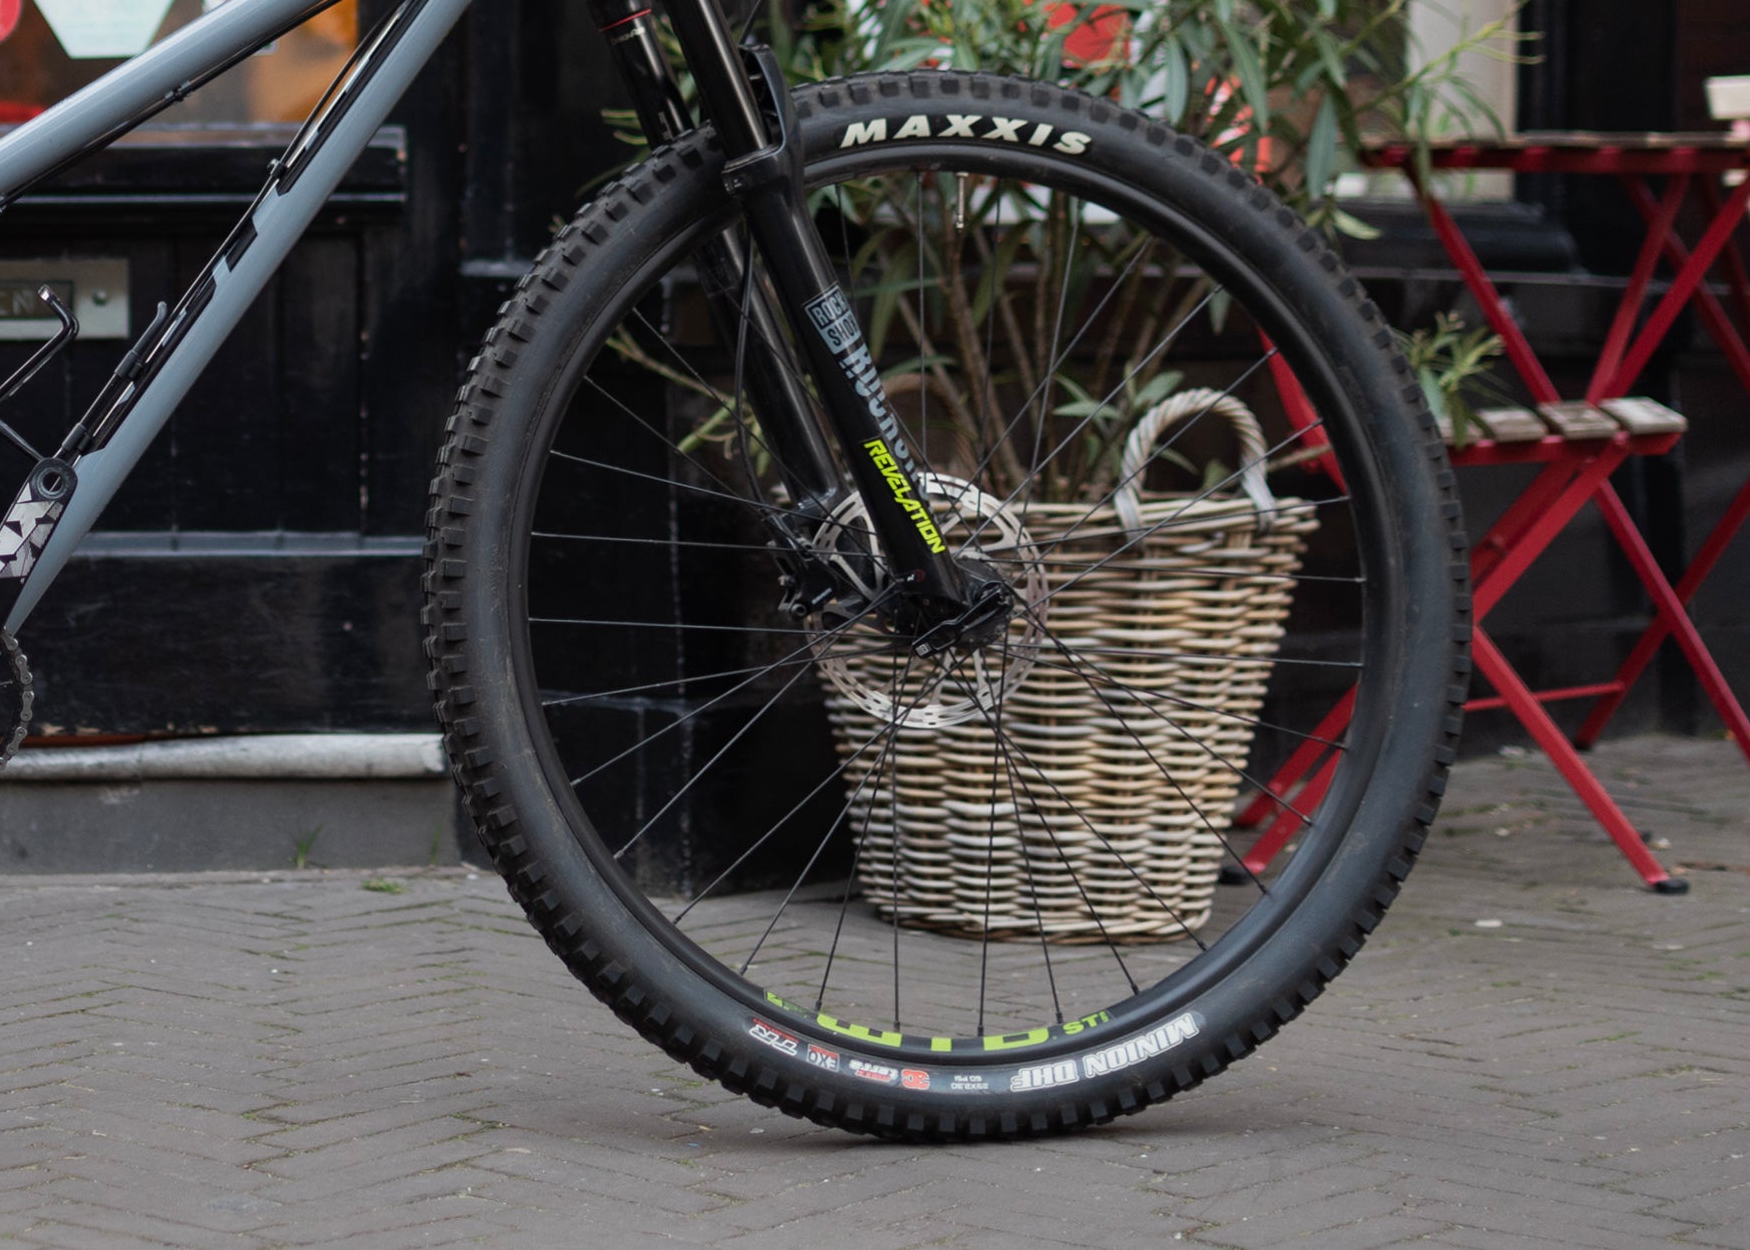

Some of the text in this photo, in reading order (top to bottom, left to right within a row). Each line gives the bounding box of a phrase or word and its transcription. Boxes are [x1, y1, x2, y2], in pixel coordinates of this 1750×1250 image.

[840, 114, 1093, 155] MAXXIS
[863, 438, 946, 555] REVELATION
[809, 1048, 839, 1072] EXO
[1010, 1012, 1201, 1093] MINION DHF
[901, 1068, 930, 1090] 3C
